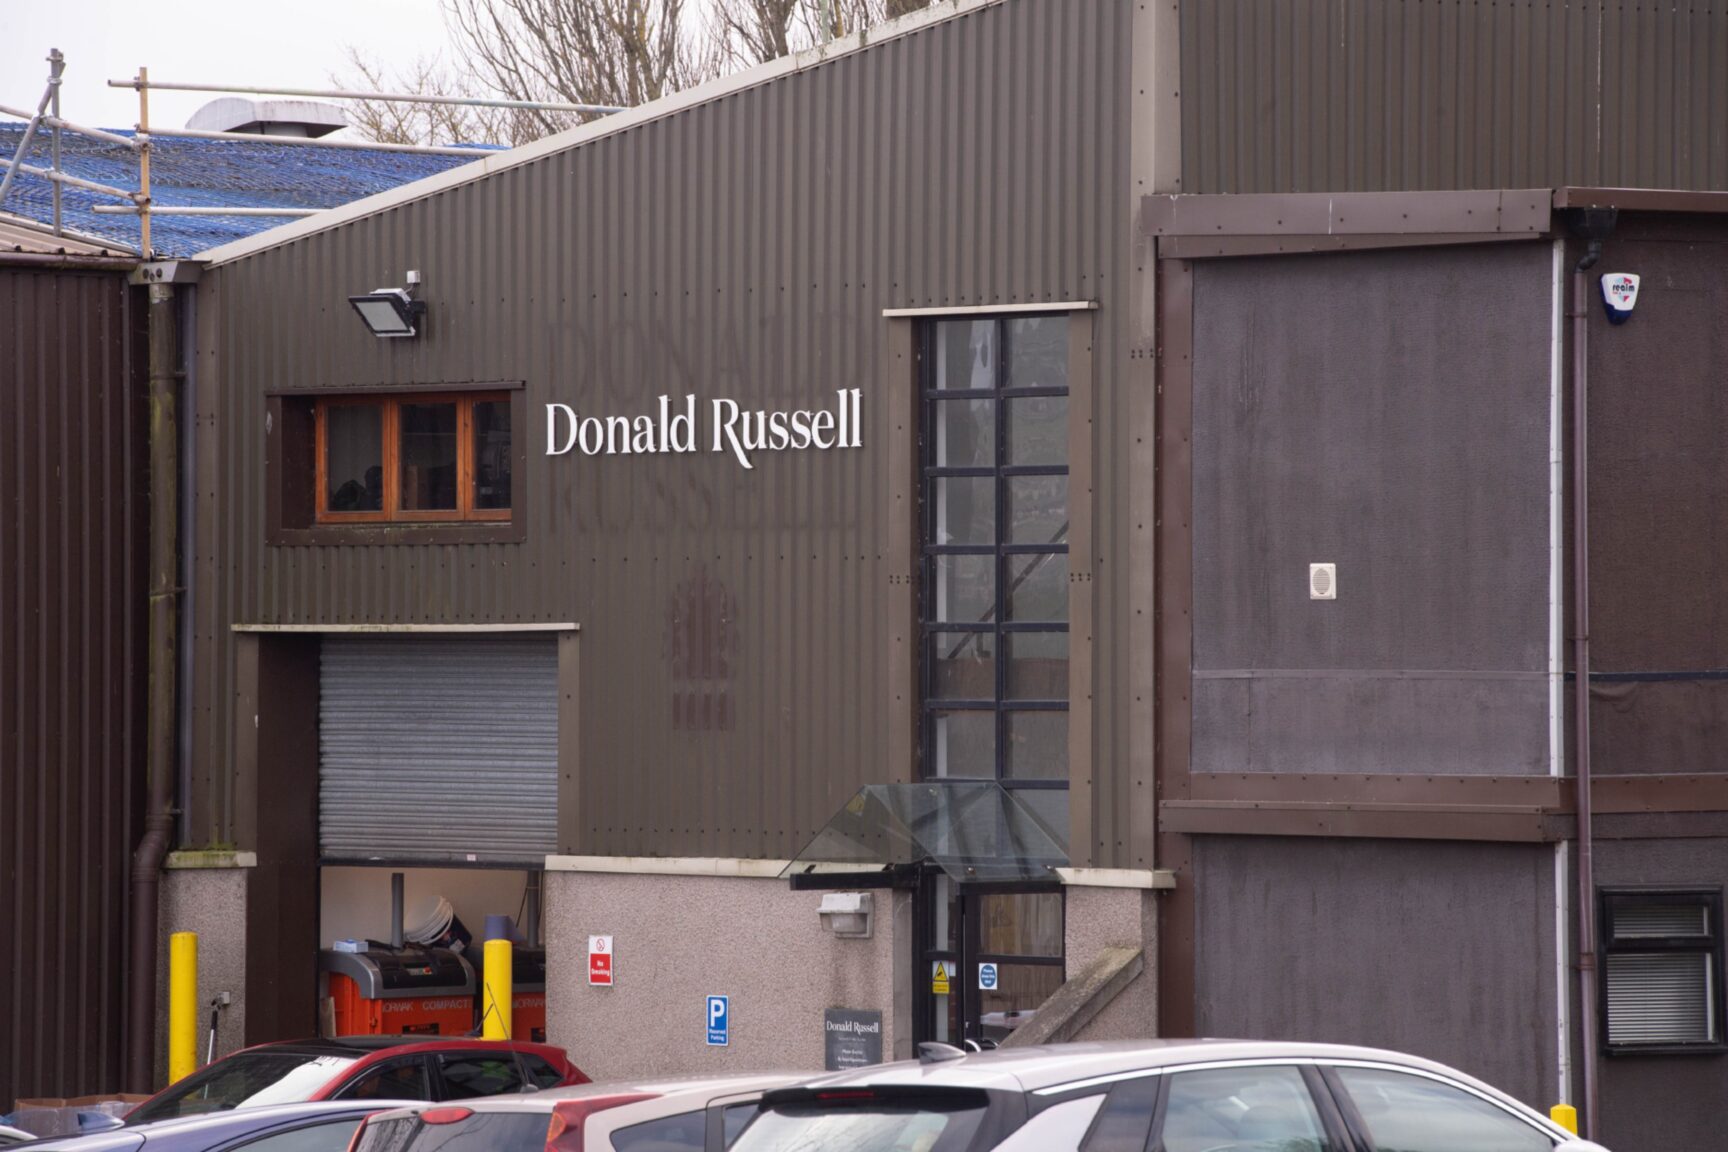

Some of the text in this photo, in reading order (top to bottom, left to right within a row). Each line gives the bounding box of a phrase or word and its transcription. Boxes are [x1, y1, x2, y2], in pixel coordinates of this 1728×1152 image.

[545, 387, 863, 470] Donald Russell
[591, 967, 610, 976] Smoking
[422, 999, 468, 1010] COMPACT
[710, 999, 725, 1028] P
[826, 1020, 879, 1035] Donald Russell
